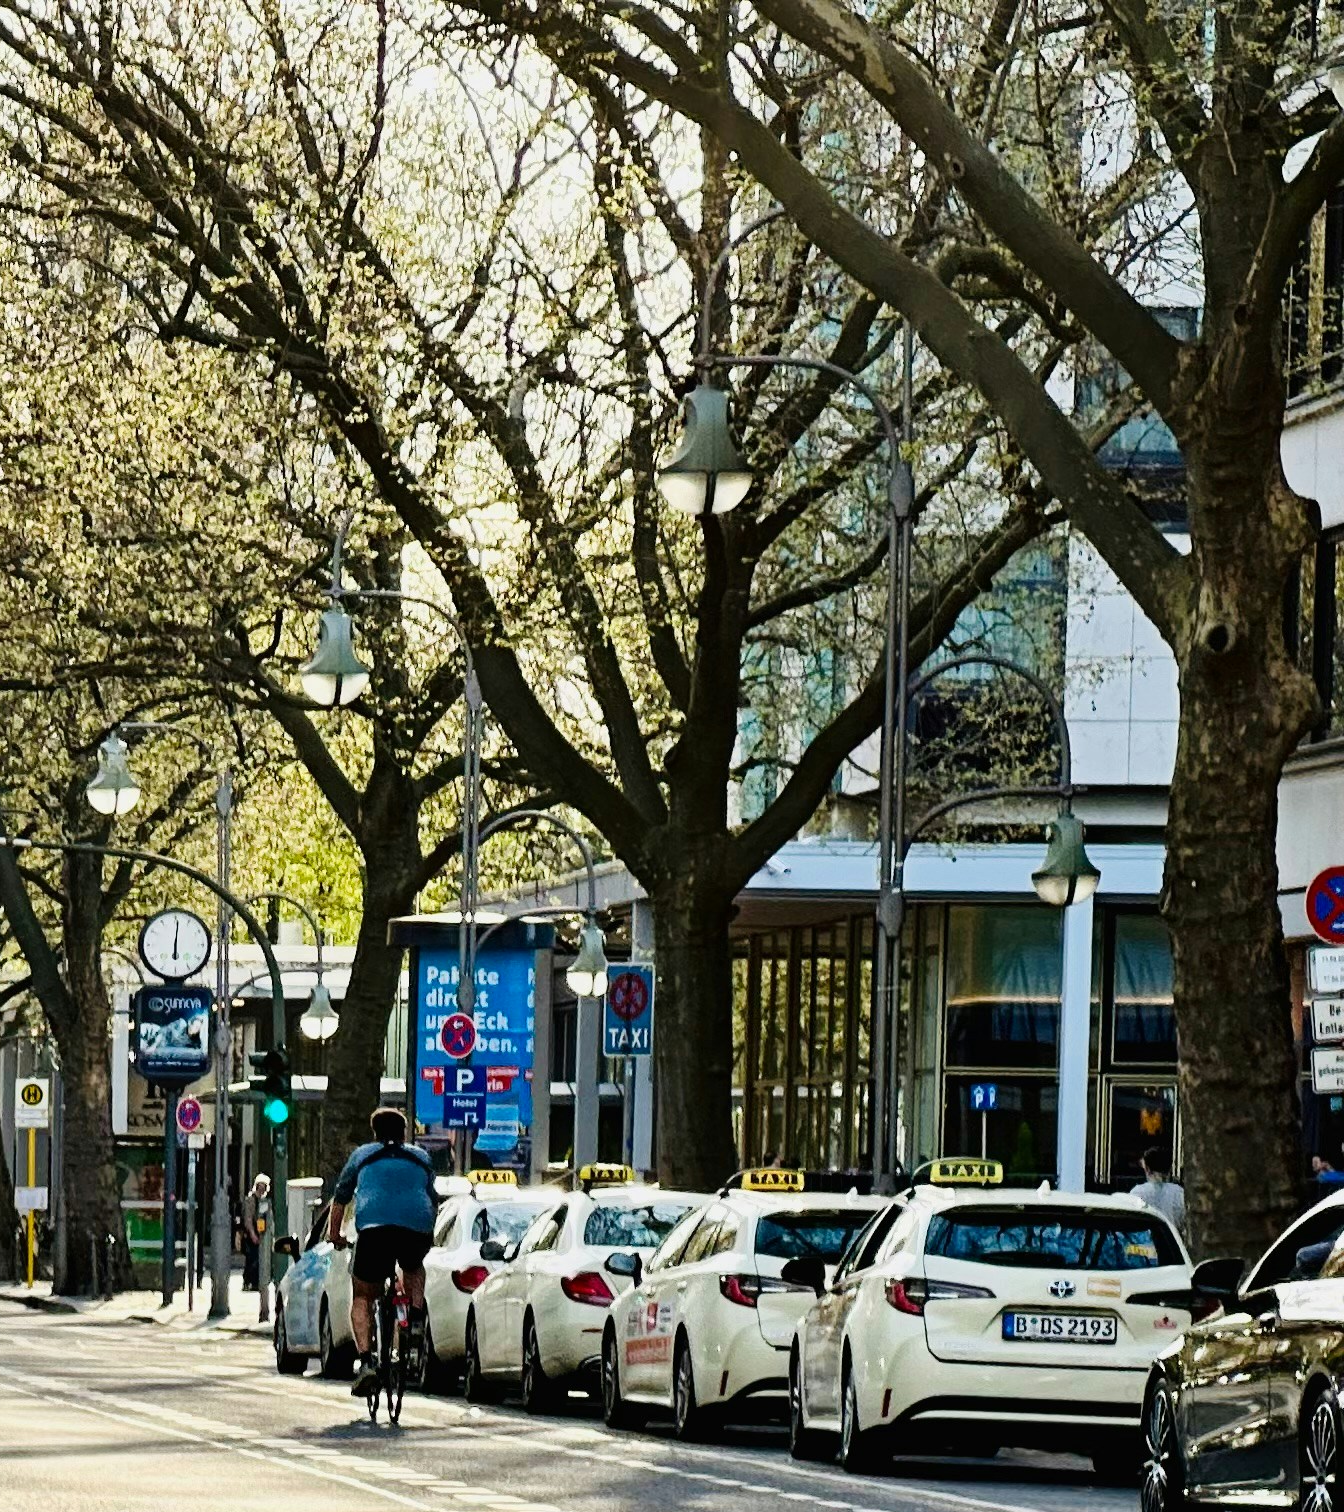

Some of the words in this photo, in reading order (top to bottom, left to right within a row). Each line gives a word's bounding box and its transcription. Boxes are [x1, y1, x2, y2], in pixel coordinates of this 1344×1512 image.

[427, 965, 499, 985] Pakte
[473, 1010, 509, 1031] Eck
[425, 1033, 517, 1053] abben.
[608, 1028, 648, 1048] TAXI
[457, 1068, 474, 1092] P
[477, 1172, 511, 1183] TAXI
[594, 1168, 629, 1182] TAXI
[755, 1173, 793, 1185] TAXI
[945, 1163, 990, 1177] TAXI
[1016, 1316, 1027, 1333] B
[1040, 1317, 1063, 1335] DS
[1068, 1319, 1113, 1337] 2193
